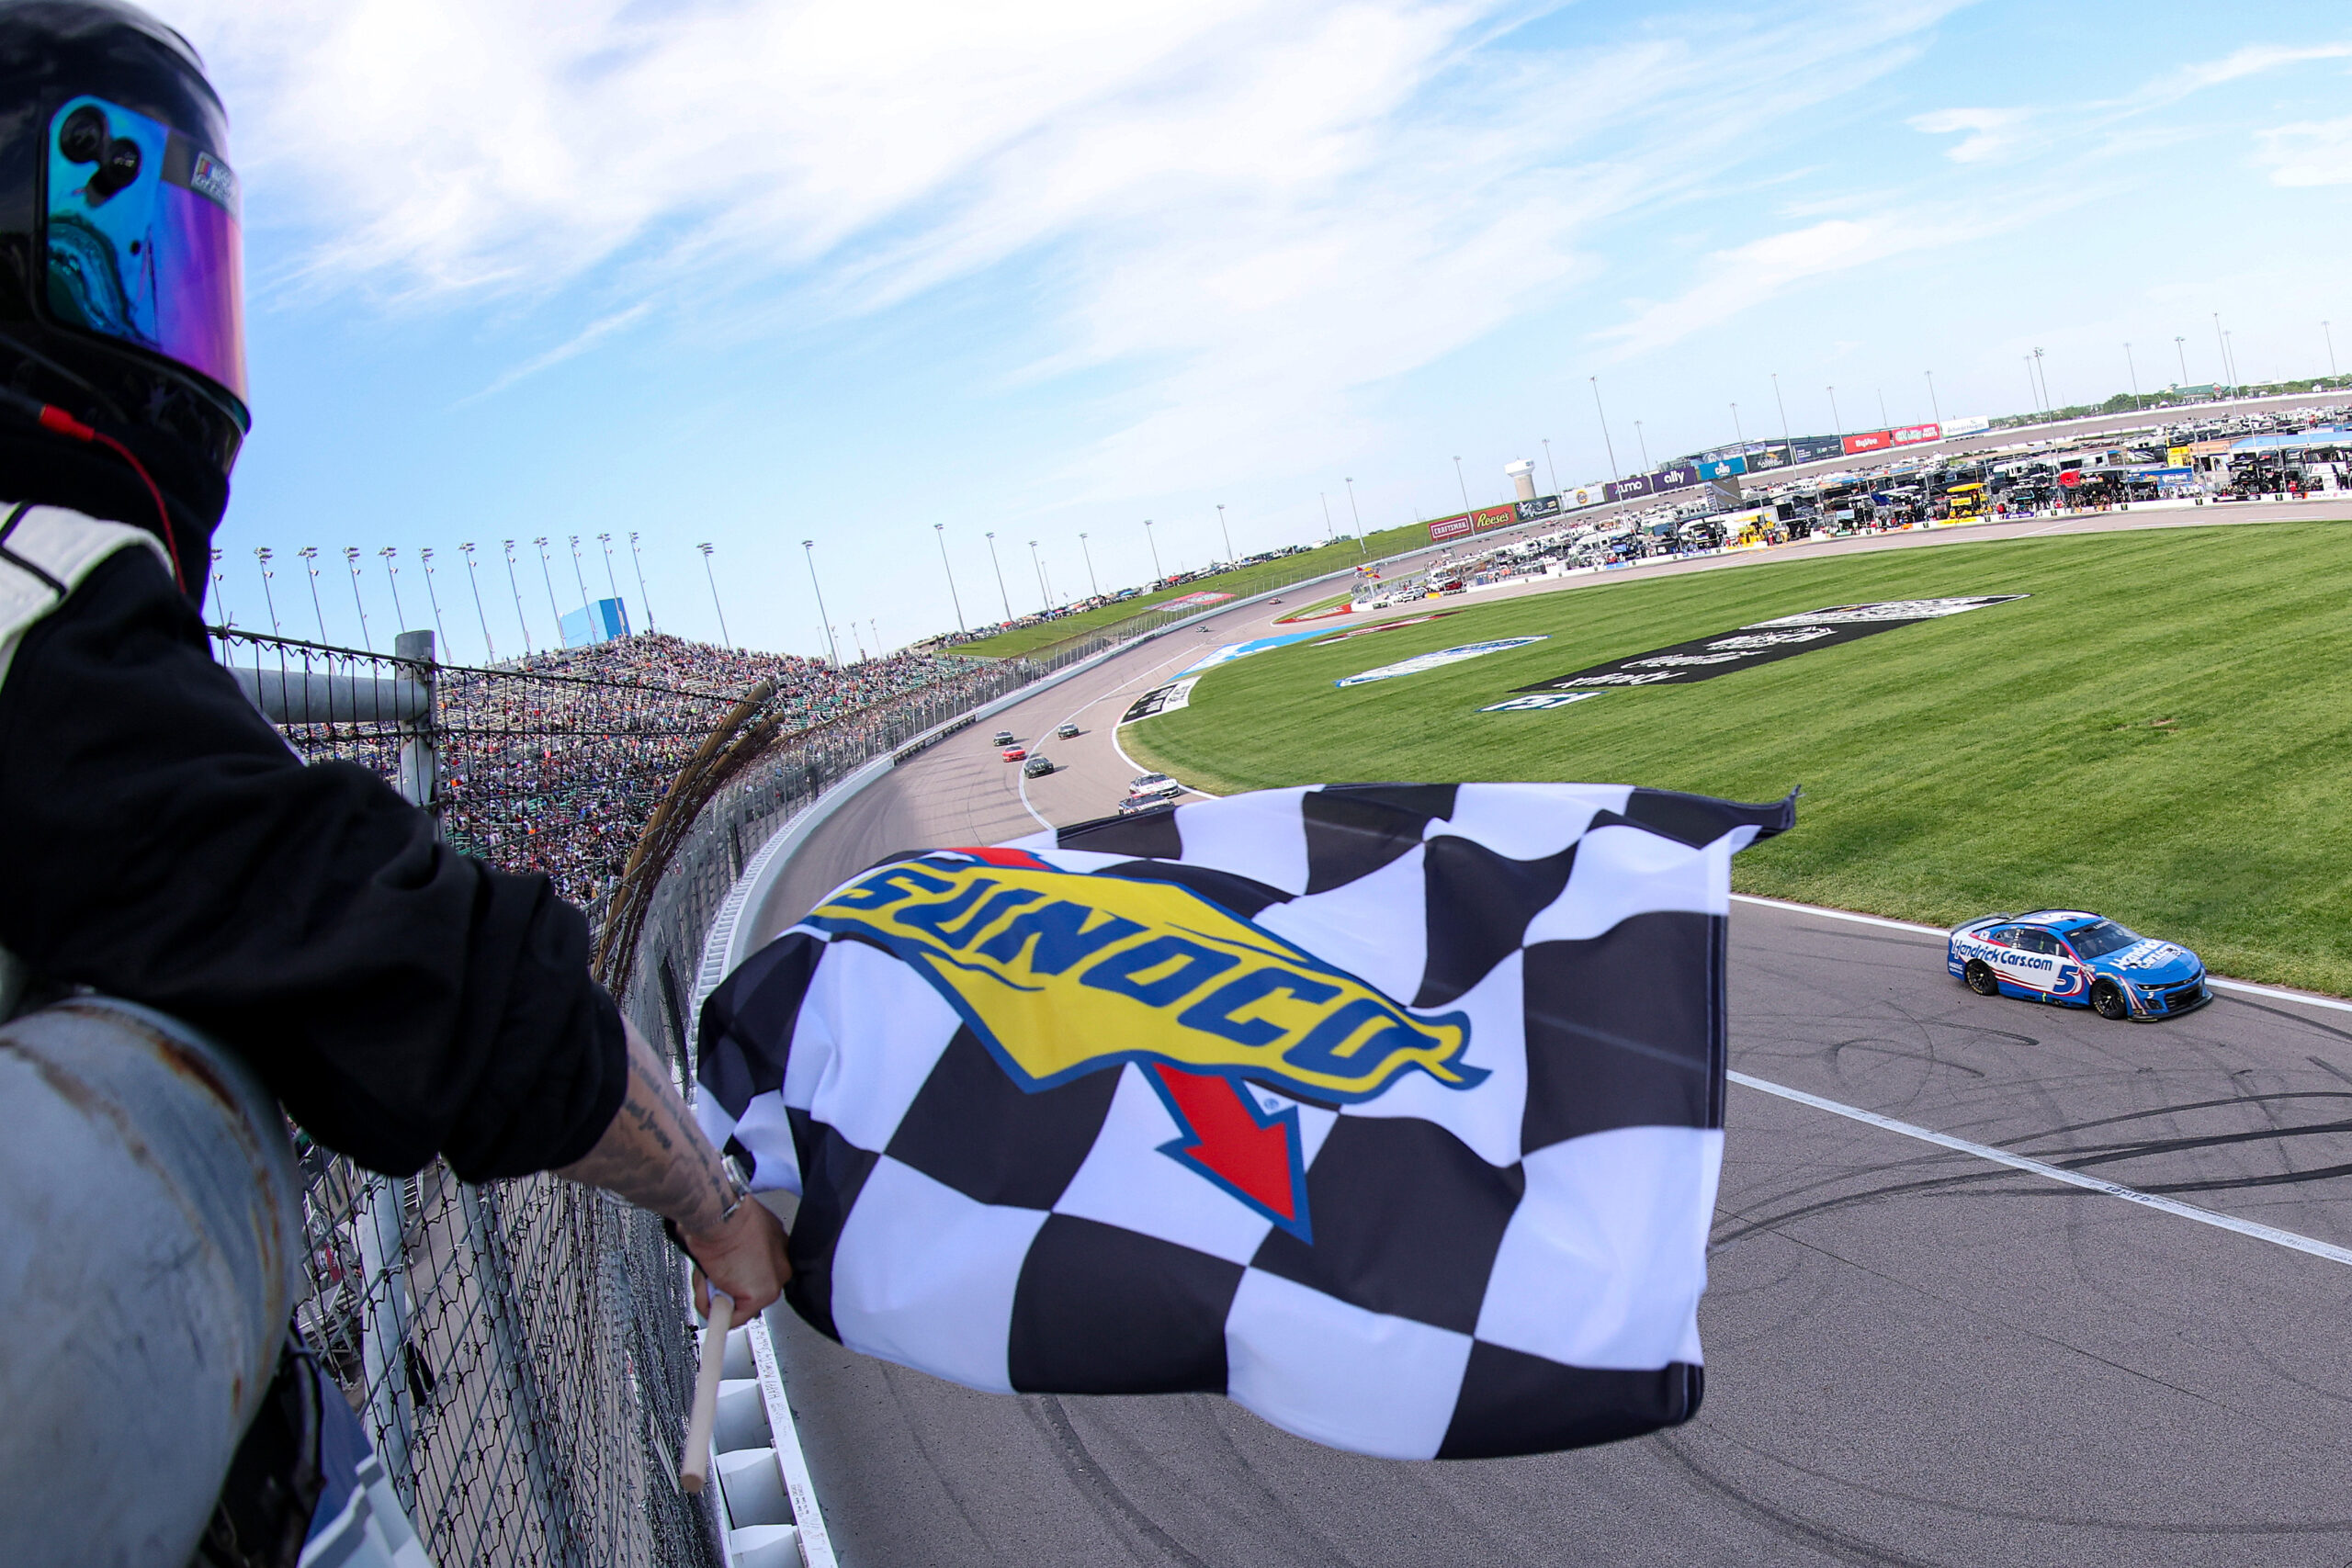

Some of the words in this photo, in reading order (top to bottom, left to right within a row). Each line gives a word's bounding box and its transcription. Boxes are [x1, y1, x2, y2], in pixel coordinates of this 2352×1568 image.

[1664, 469, 1685, 484] ally
[1476, 512, 1510, 528] Reese's
[1433, 521, 1467, 535] CRAFTSMAN
[830, 868, 1442, 1074] SUNOCO
[2052, 964, 2080, 994] 5
[2146, 991, 2154, 999] 5
